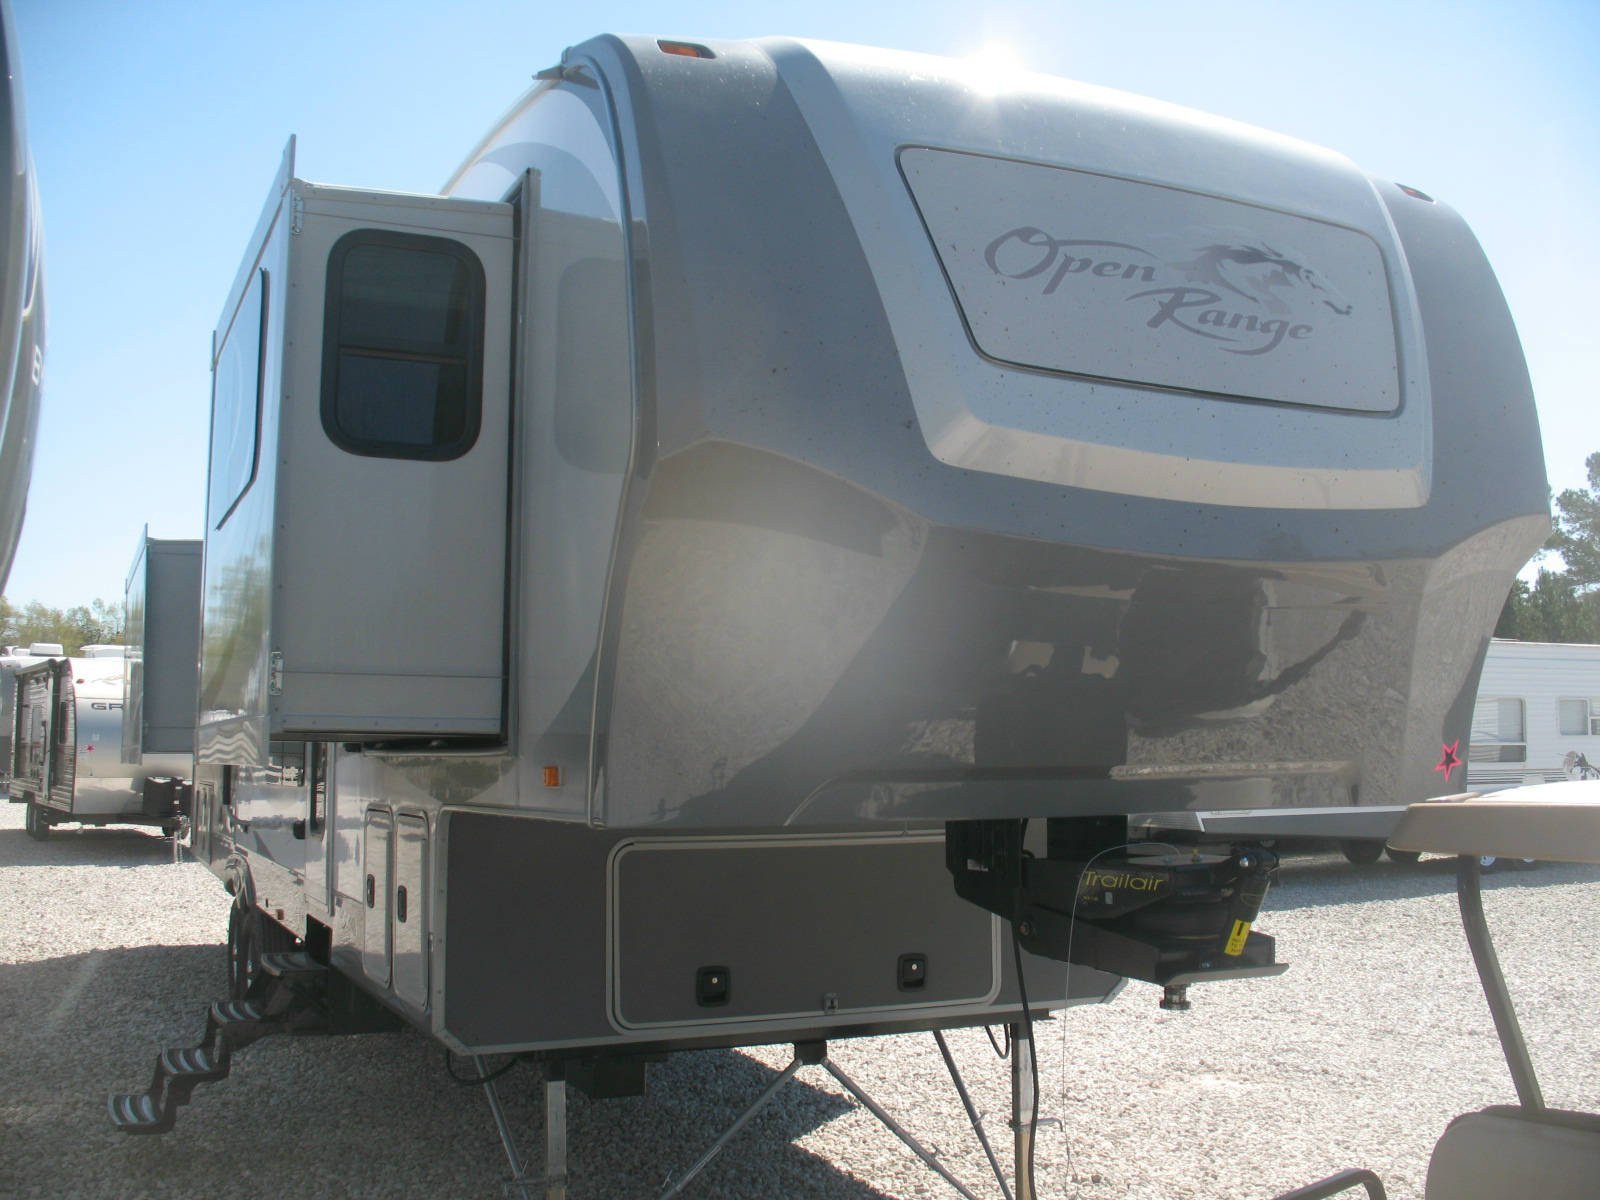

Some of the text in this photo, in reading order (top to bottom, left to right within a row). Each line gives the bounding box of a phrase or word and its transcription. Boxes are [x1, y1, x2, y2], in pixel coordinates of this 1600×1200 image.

[984, 226, 1158, 295] Open
[1125, 287, 1313, 355] Range
[1085, 871, 1164, 891] Trailair
